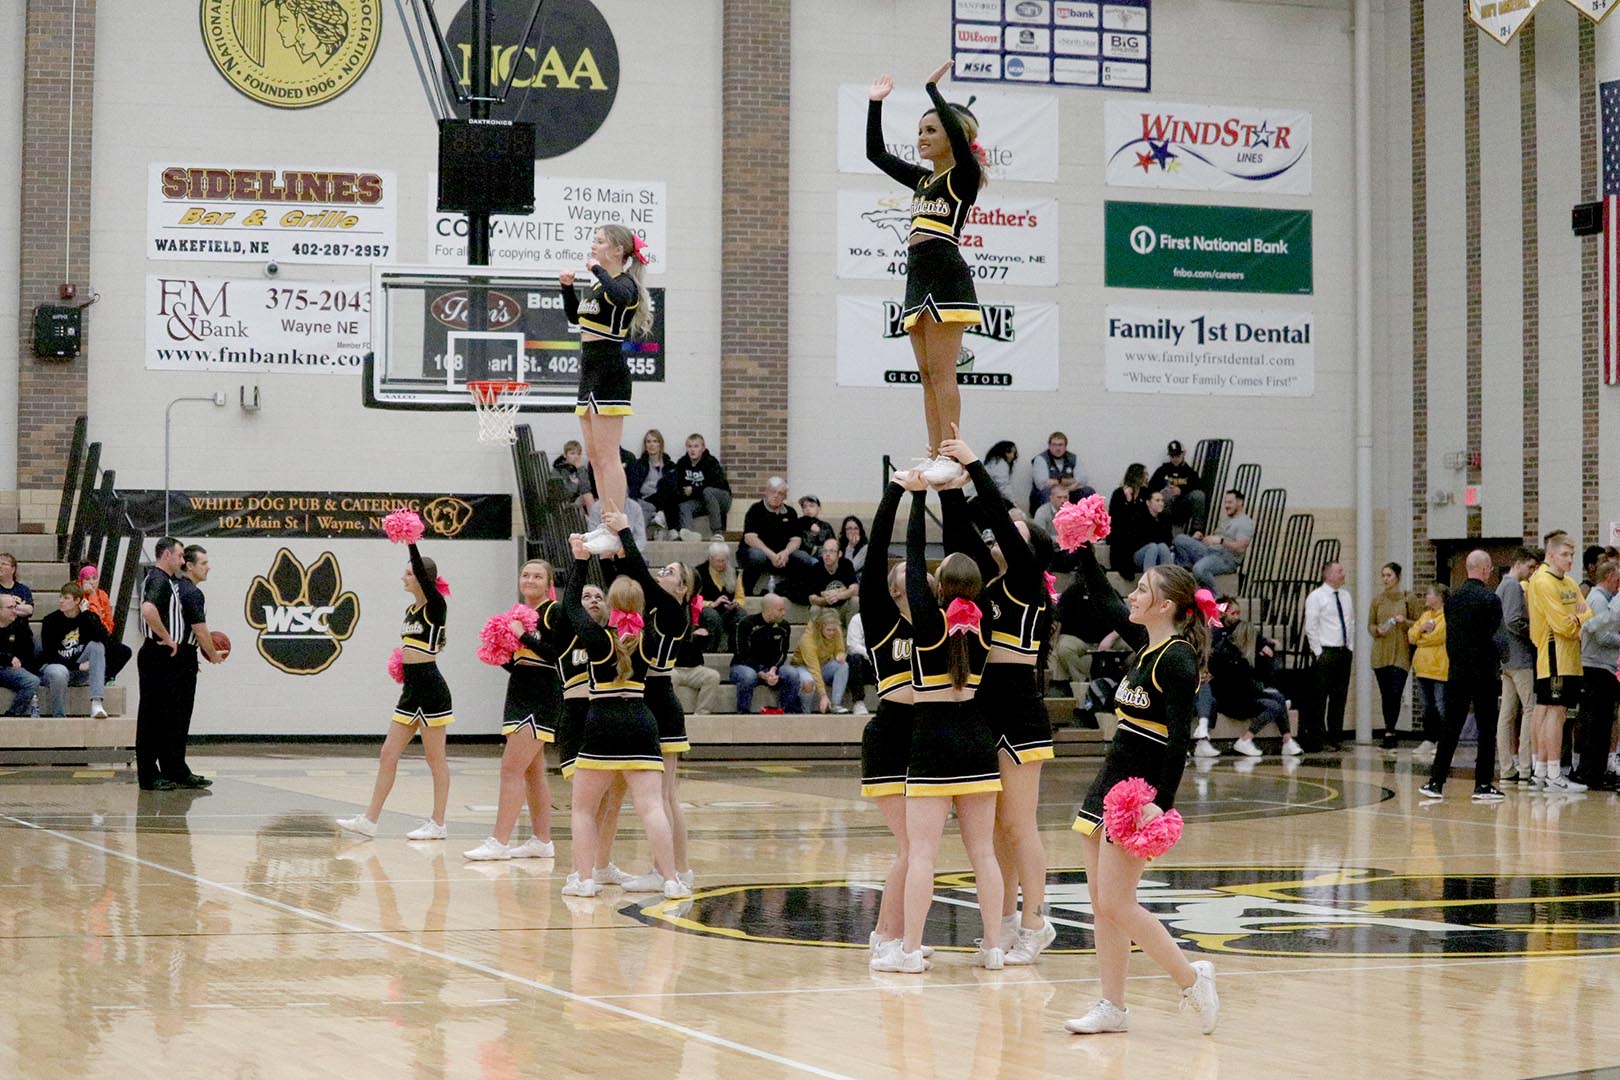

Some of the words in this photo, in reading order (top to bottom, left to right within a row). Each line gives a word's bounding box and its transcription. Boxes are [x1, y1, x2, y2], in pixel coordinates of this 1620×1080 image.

[958, 31, 997, 43] Wilson
[458, 43, 608, 90] NCAA
[964, 62, 992, 73] NSIC
[243, 74, 303, 99] FOUNDED
[306, 77, 336, 97] 1906
[468, 118, 513, 126] DAKTRONICS
[1237, 153, 1263, 163] LINES
[162, 167, 383, 204] SIDELINES
[563, 187, 592, 201] 216
[597, 188, 634, 203] Main
[639, 190, 658, 205] St.
[911, 196, 950, 216] ldcats
[178, 208, 236, 226] Bar
[242, 209, 267, 227] &
[279, 210, 359, 229] Grille
[567, 206, 625, 224] Wayne,
[630, 209, 653, 223] NE
[966, 206, 1038, 228] father's
[155, 239, 246, 255] WAKEFIELD,
[250, 242, 269, 253] NE
[292, 243, 389, 257] 402-287-2957
[435, 244, 453, 256] For
[498, 247, 540, 261] copying
[543, 248, 552, 259] &
[555, 249, 584, 260] office
[849, 248, 871, 256] 106
[1160, 234, 1190, 250] First
[1193, 236, 1251, 253] National
[1254, 239, 1288, 254] Bank
[975, 253, 1025, 264] Wayne,
[1029, 255, 1046, 263] NE
[1173, 267, 1244, 280] fnbo.com/careers
[265, 288, 371, 313] 375-2043
[527, 293, 564, 309] Bod
[200, 319, 249, 337] Bank
[281, 319, 332, 336] Wayne
[337, 321, 358, 334] NE
[1109, 319, 1185, 346] Family
[1191, 315, 1228, 345] 1st
[1235, 323, 1310, 344] Dental
[156, 347, 361, 366] www.fmbankne.co
[488, 355, 512, 371] arl
[1125, 352, 1295, 366] www.familyfirstdental.com
[963, 374, 1008, 384] STORE
[1165, 373, 1190, 384] Your
[1192, 374, 1226, 387] Family
[1229, 375, 1263, 386] Comes
[190, 497, 244, 510] WHITE
[248, 497, 284, 510] DOG
[289, 498, 320, 511] PUB
[325, 499, 337, 511] &
[341, 499, 420, 512] CATERING
[219, 516, 241, 528] 102
[246, 516, 280, 528] Main
[285, 516, 298, 528] St
[317, 516, 364, 532] Wayne,
[262, 605, 335, 633] WSC
